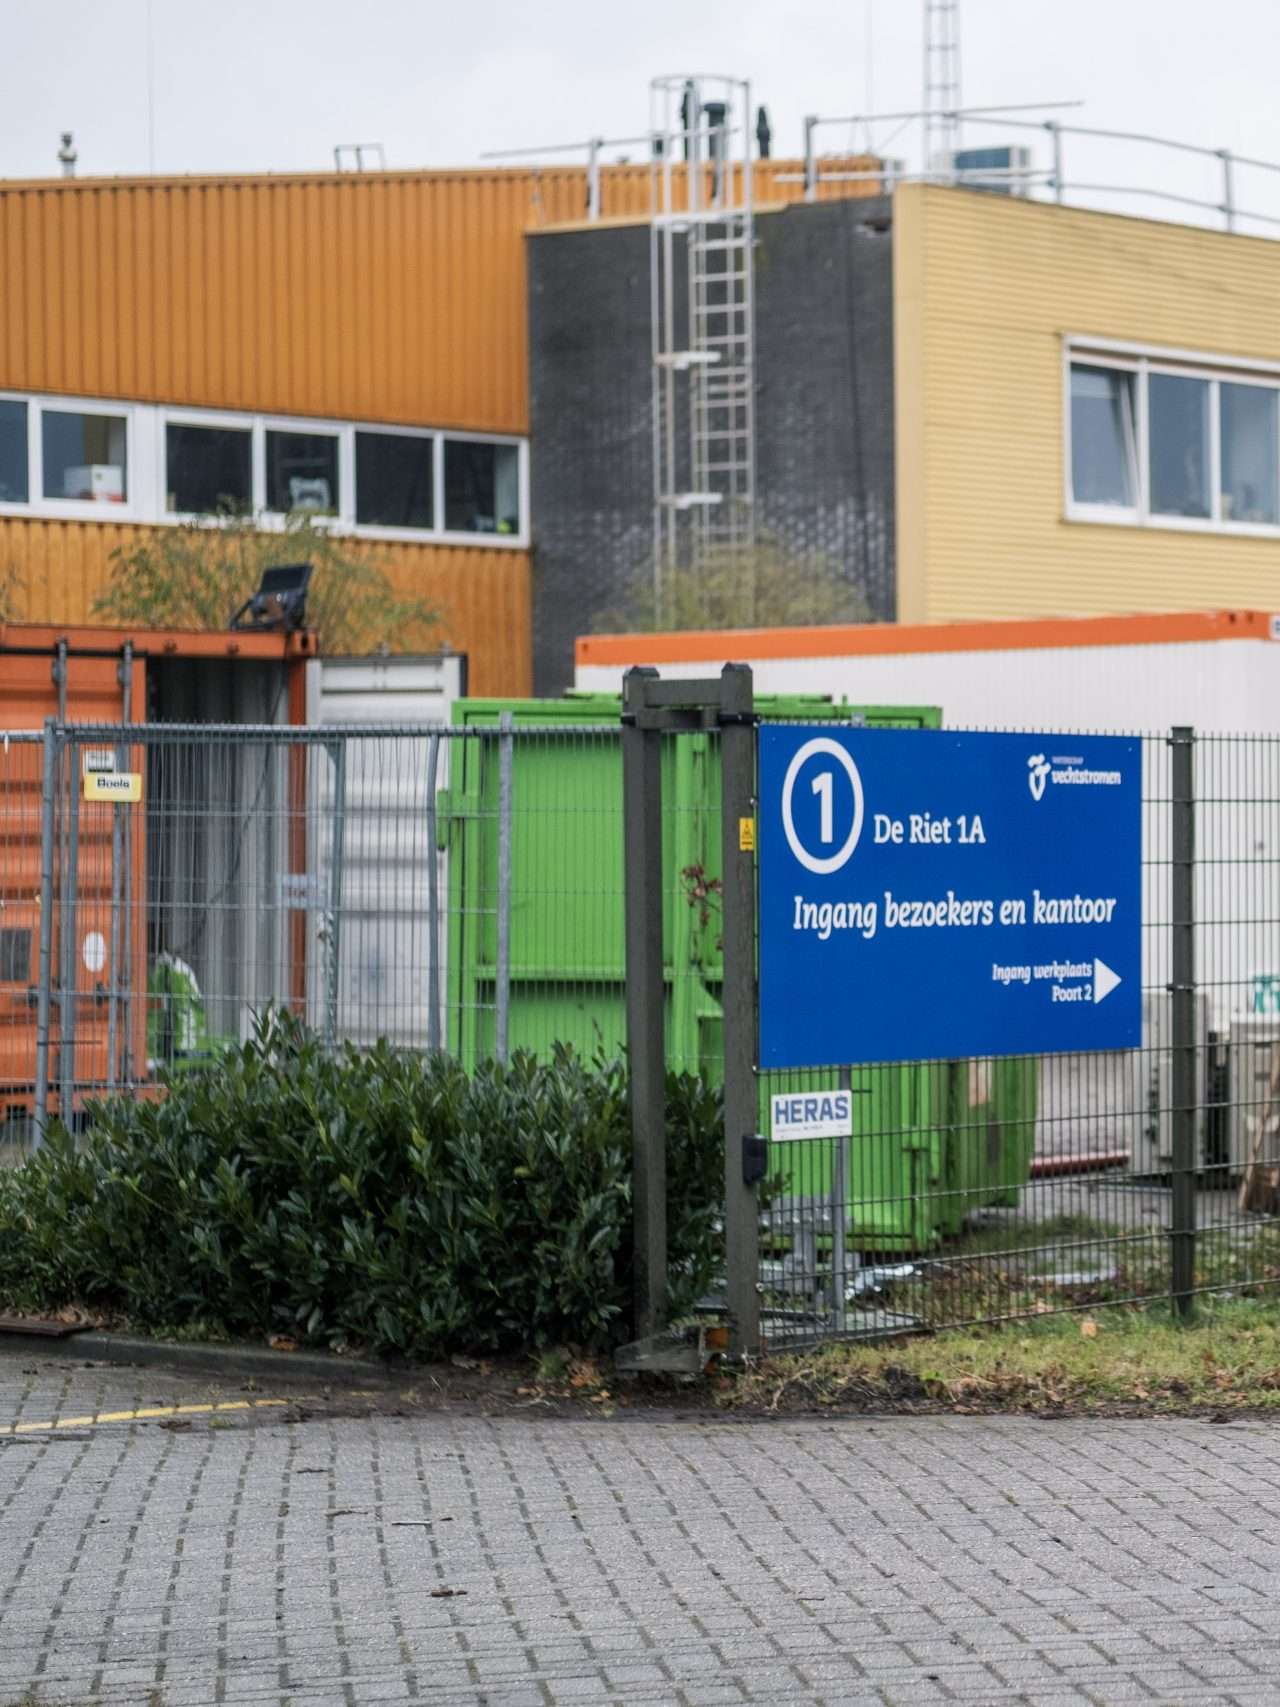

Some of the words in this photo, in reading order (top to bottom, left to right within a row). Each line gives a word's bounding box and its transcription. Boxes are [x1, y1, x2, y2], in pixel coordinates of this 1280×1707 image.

[1052, 767, 1121, 784] vechtstromen
[812, 773, 832, 842] 1
[875, 815, 903, 843] De
[910, 813, 951, 843] Riet
[957, 816, 986, 843] 1A
[794, 896, 877, 939] Ingang
[885, 891, 993, 927] bezoekers
[1000, 900, 1025, 925] en
[1034, 890, 1116, 923] kantoor
[993, 964, 1031, 984] Ingang
[1034, 961, 1092, 982] werkplaats
[1053, 986, 1082, 1001] Poort
[1084, 983, 1092, 1001] 2
[775, 1096, 849, 1125] HERAS
